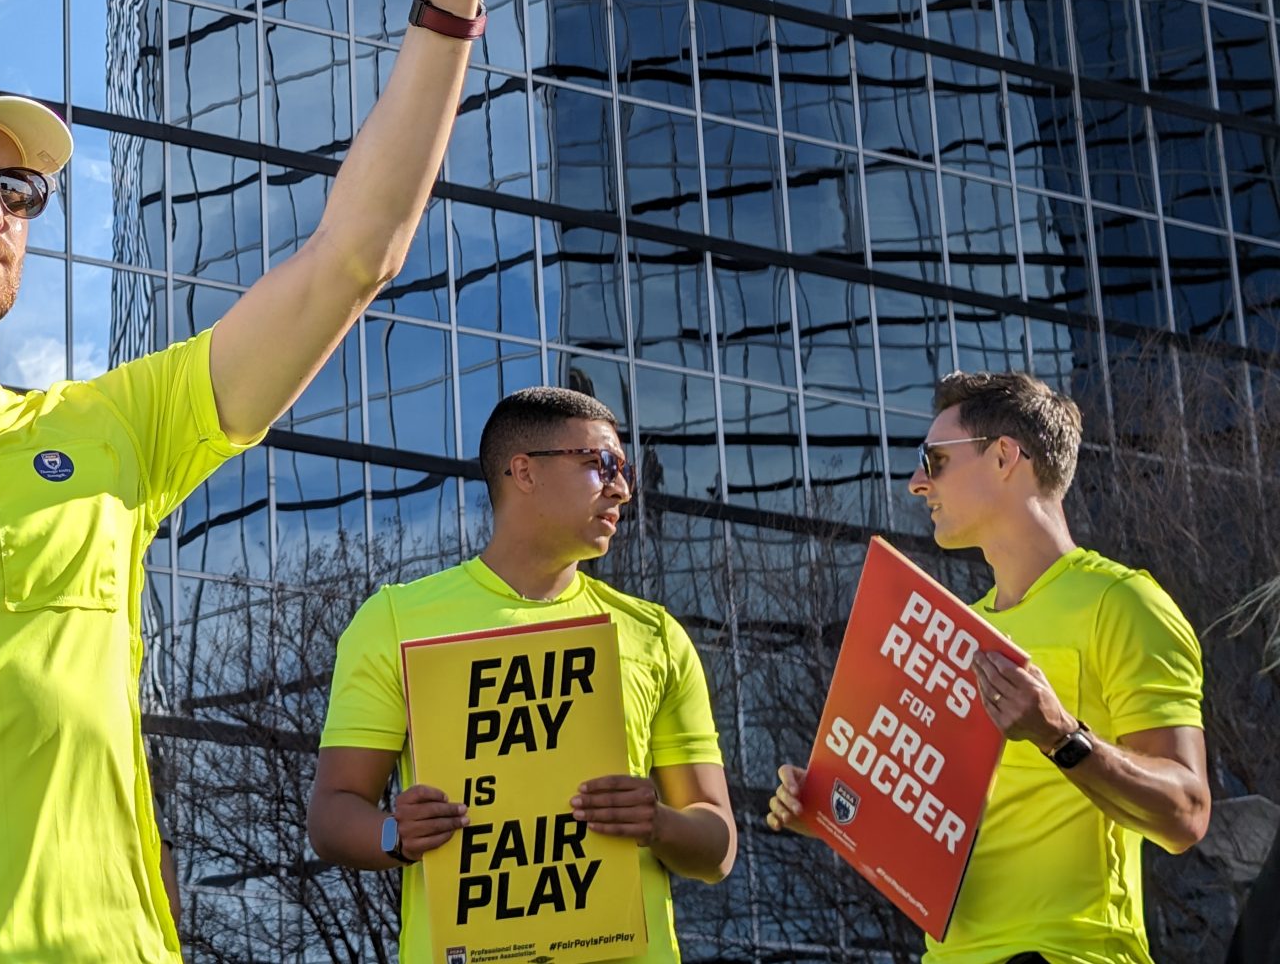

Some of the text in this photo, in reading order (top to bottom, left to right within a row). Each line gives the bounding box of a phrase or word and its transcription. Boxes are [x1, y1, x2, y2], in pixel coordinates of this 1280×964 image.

[900, 590, 979, 671] PRO
[468, 647, 596, 709] FAIR
[880, 623, 976, 718] REFS
[465, 700, 574, 760] PAY
[899, 688, 936, 728] FOR
[868, 704, 945, 785] PRO
[463, 775, 496, 807] IS
[825, 716, 966, 854] SOCCER
[460, 812, 587, 874] FAIR
[456, 859, 602, 925] PLAY
[549, 932, 635, 952] #FairPayIsFairPlay
